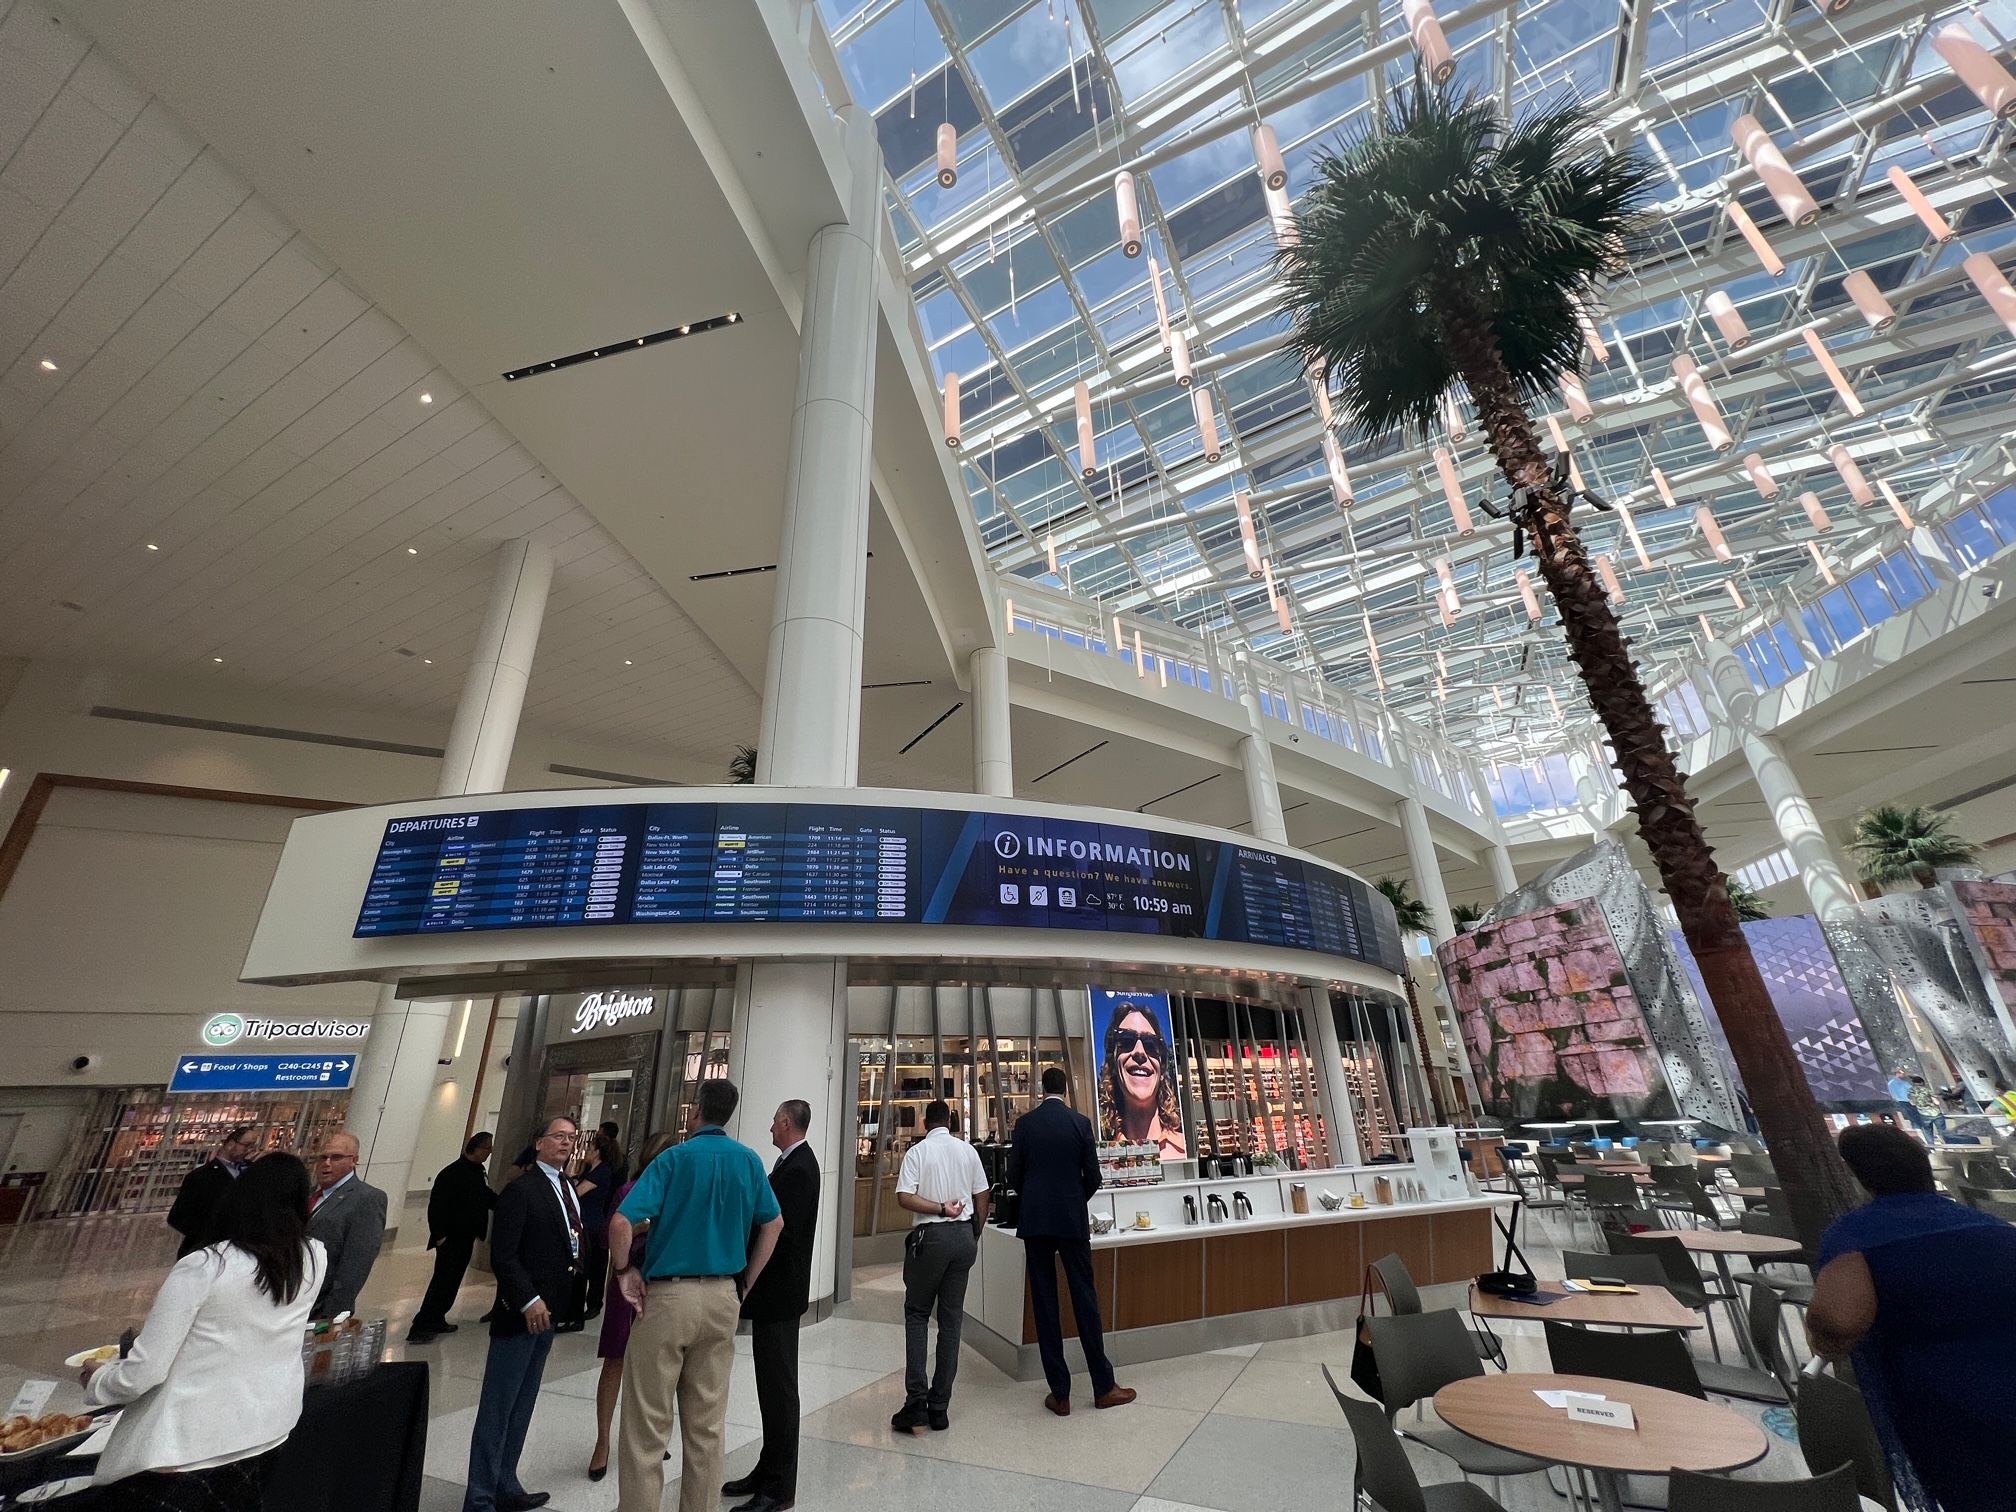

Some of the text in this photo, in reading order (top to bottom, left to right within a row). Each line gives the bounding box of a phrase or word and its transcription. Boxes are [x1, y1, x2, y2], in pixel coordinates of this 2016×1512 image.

[389, 817, 466, 834] DEPARTURES
[1028, 836, 1191, 872] INFORMATION
[1238, 849, 1270, 864] ARRIVALS
[999, 865, 1192, 890] Have a question? We have answers.
[1119, 902, 1125, 910] C
[1133, 896, 1192, 915] 10:59 am
[571, 992, 654, 1034] Brighton
[246, 1020, 369, 1040] Tripadvisor
[1576, 1407, 1615, 1418] RESERVED
